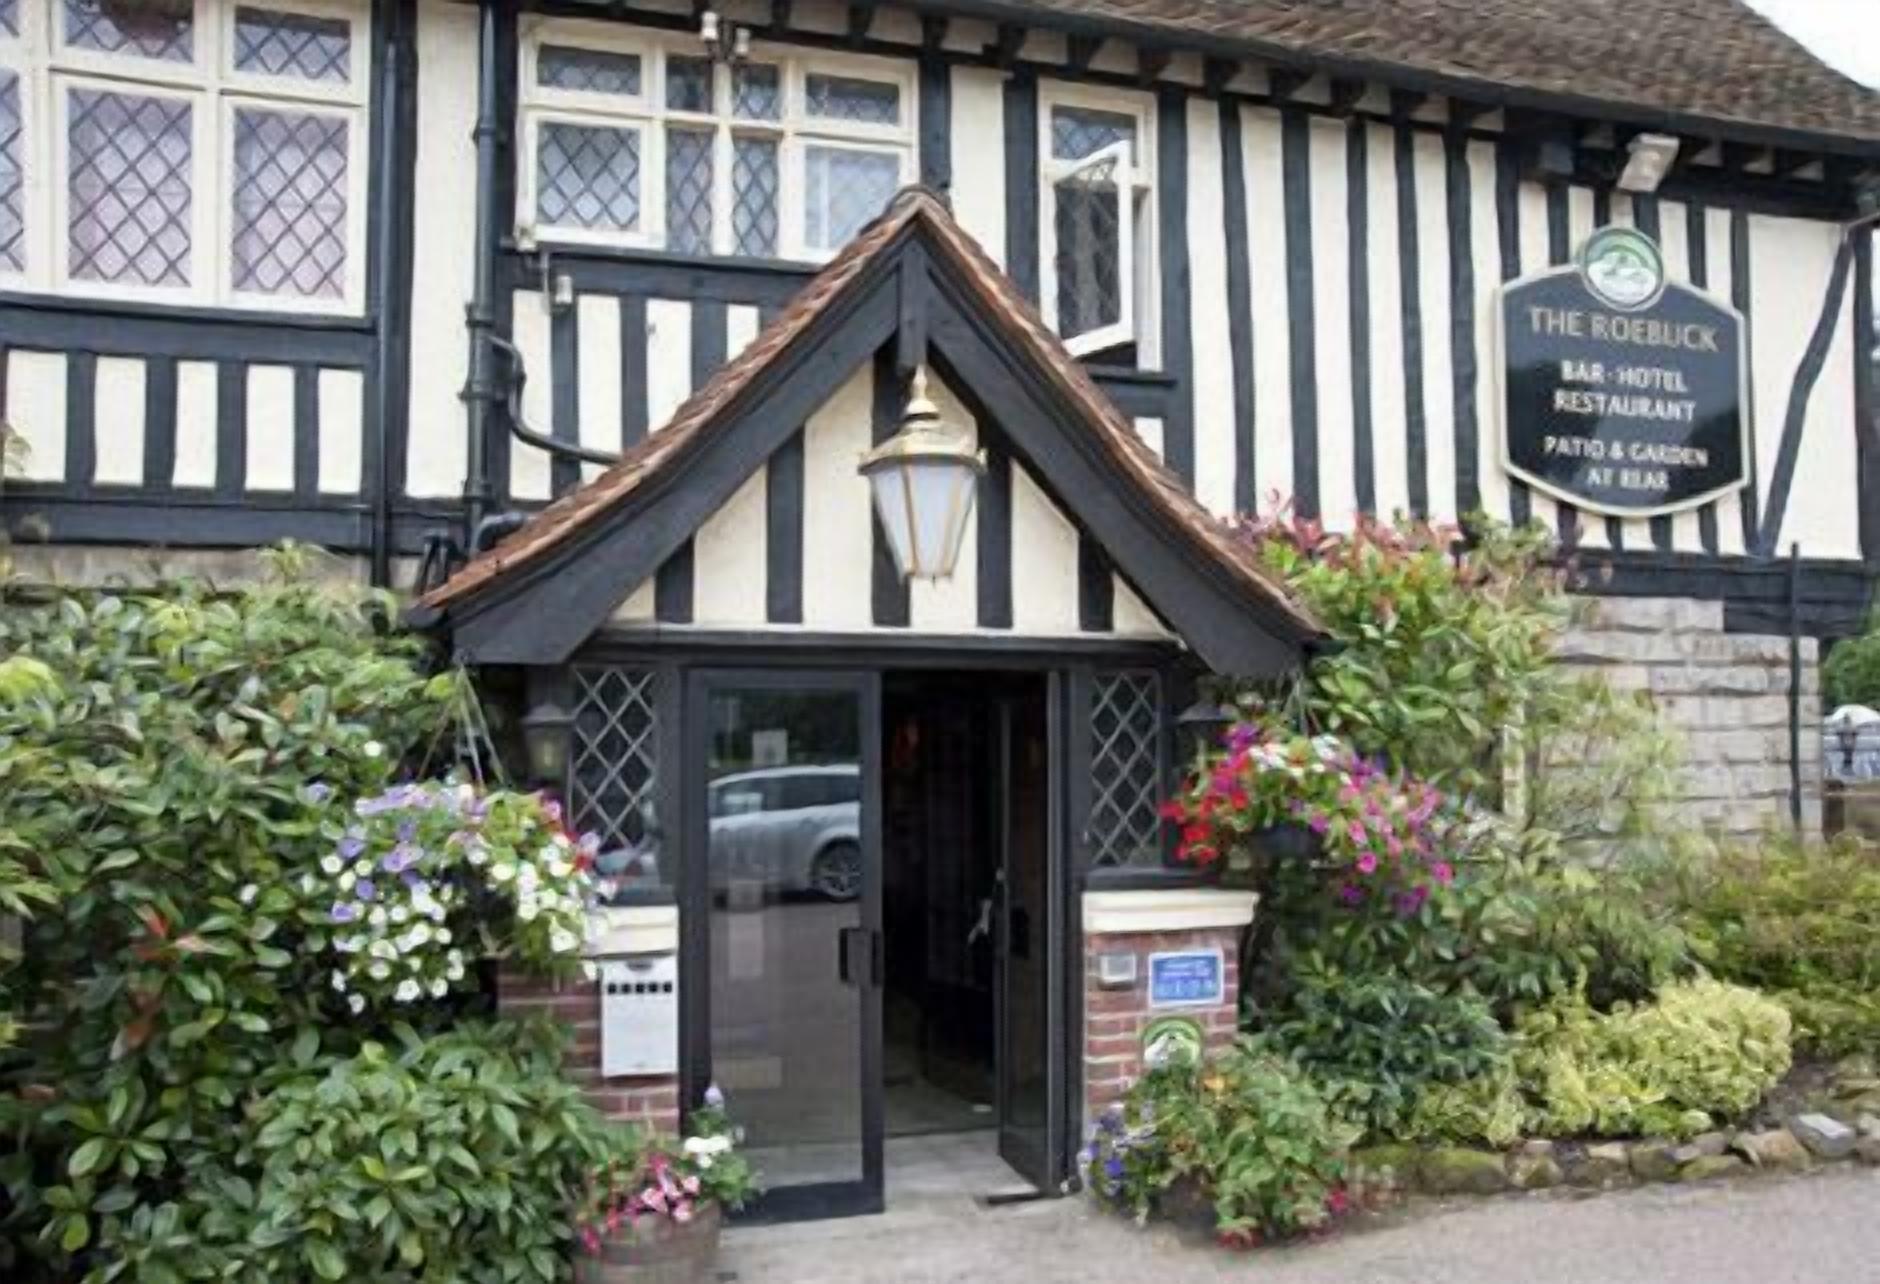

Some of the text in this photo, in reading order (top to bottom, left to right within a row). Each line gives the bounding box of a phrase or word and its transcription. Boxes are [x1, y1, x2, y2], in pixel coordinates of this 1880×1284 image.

[1531, 306, 1720, 352] THE ROEBUCK
[1561, 360, 1688, 392] BAR HOTEL
[1554, 389, 1696, 421] RESTAURANT
[1544, 435, 1708, 467] PATIO & GARDEN
[1587, 467, 1613, 487] AT
